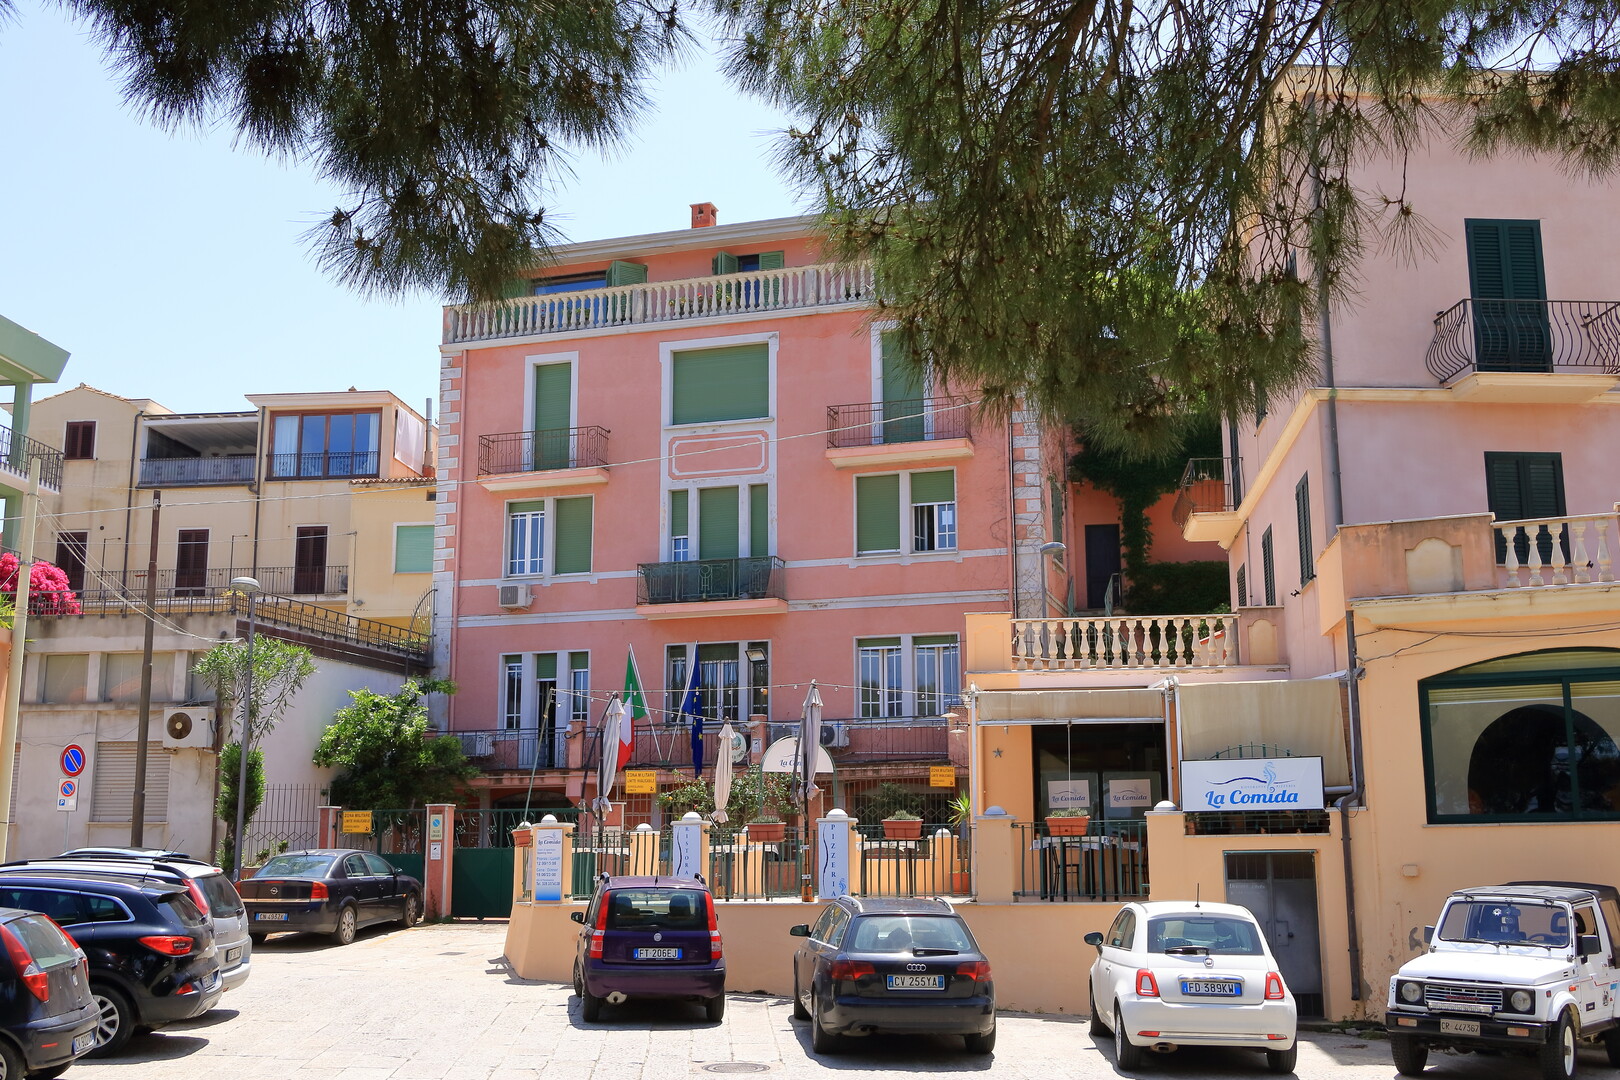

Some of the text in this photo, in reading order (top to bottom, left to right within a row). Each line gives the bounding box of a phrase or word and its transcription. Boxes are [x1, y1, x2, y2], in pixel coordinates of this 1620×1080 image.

[1205, 790, 1299, 808] La Comida
[639, 949, 677, 957] FT 206EJ
[894, 976, 938, 986] CV 255YA
[1188, 982, 1234, 993] FD 389KW
